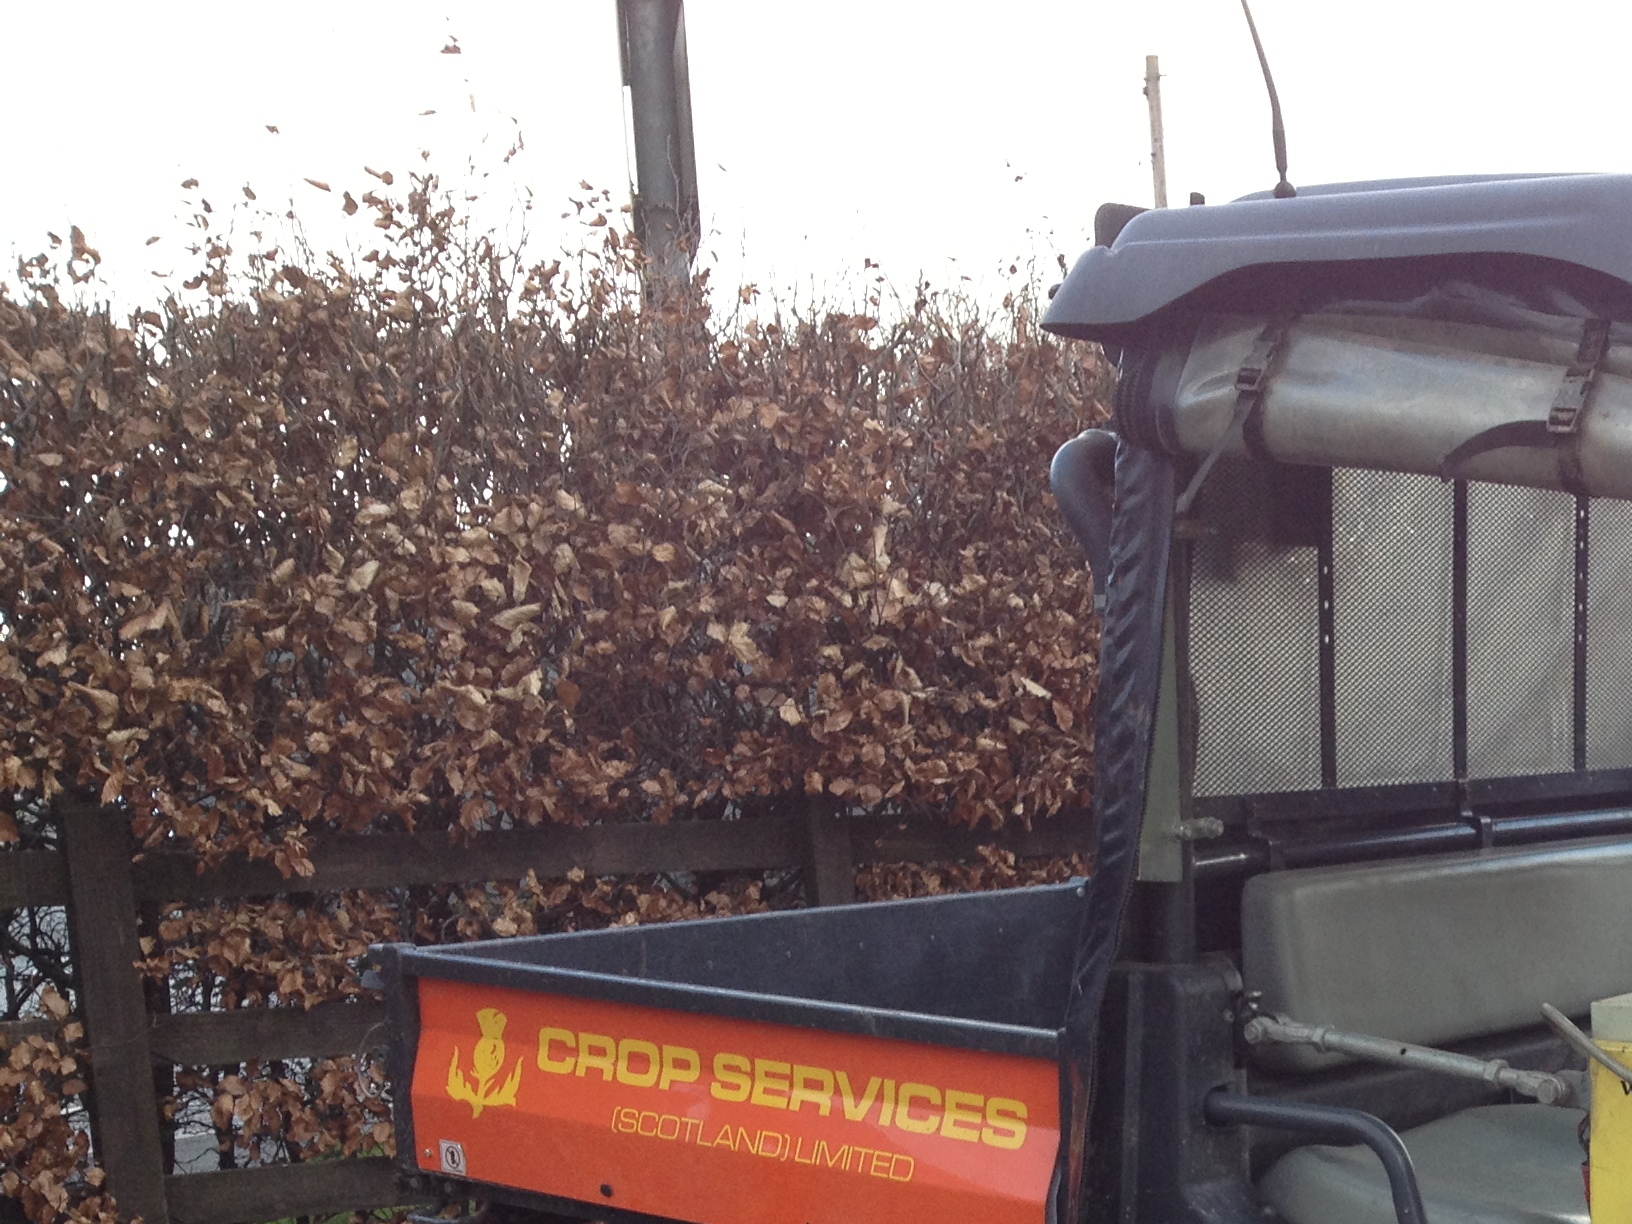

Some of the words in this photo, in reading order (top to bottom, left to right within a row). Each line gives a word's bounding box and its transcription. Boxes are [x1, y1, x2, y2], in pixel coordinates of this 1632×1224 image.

[536, 1025, 701, 1092] CROP
[709, 1052, 1029, 1151] SERVICES
[793, 1134, 915, 1183] LIMITED
